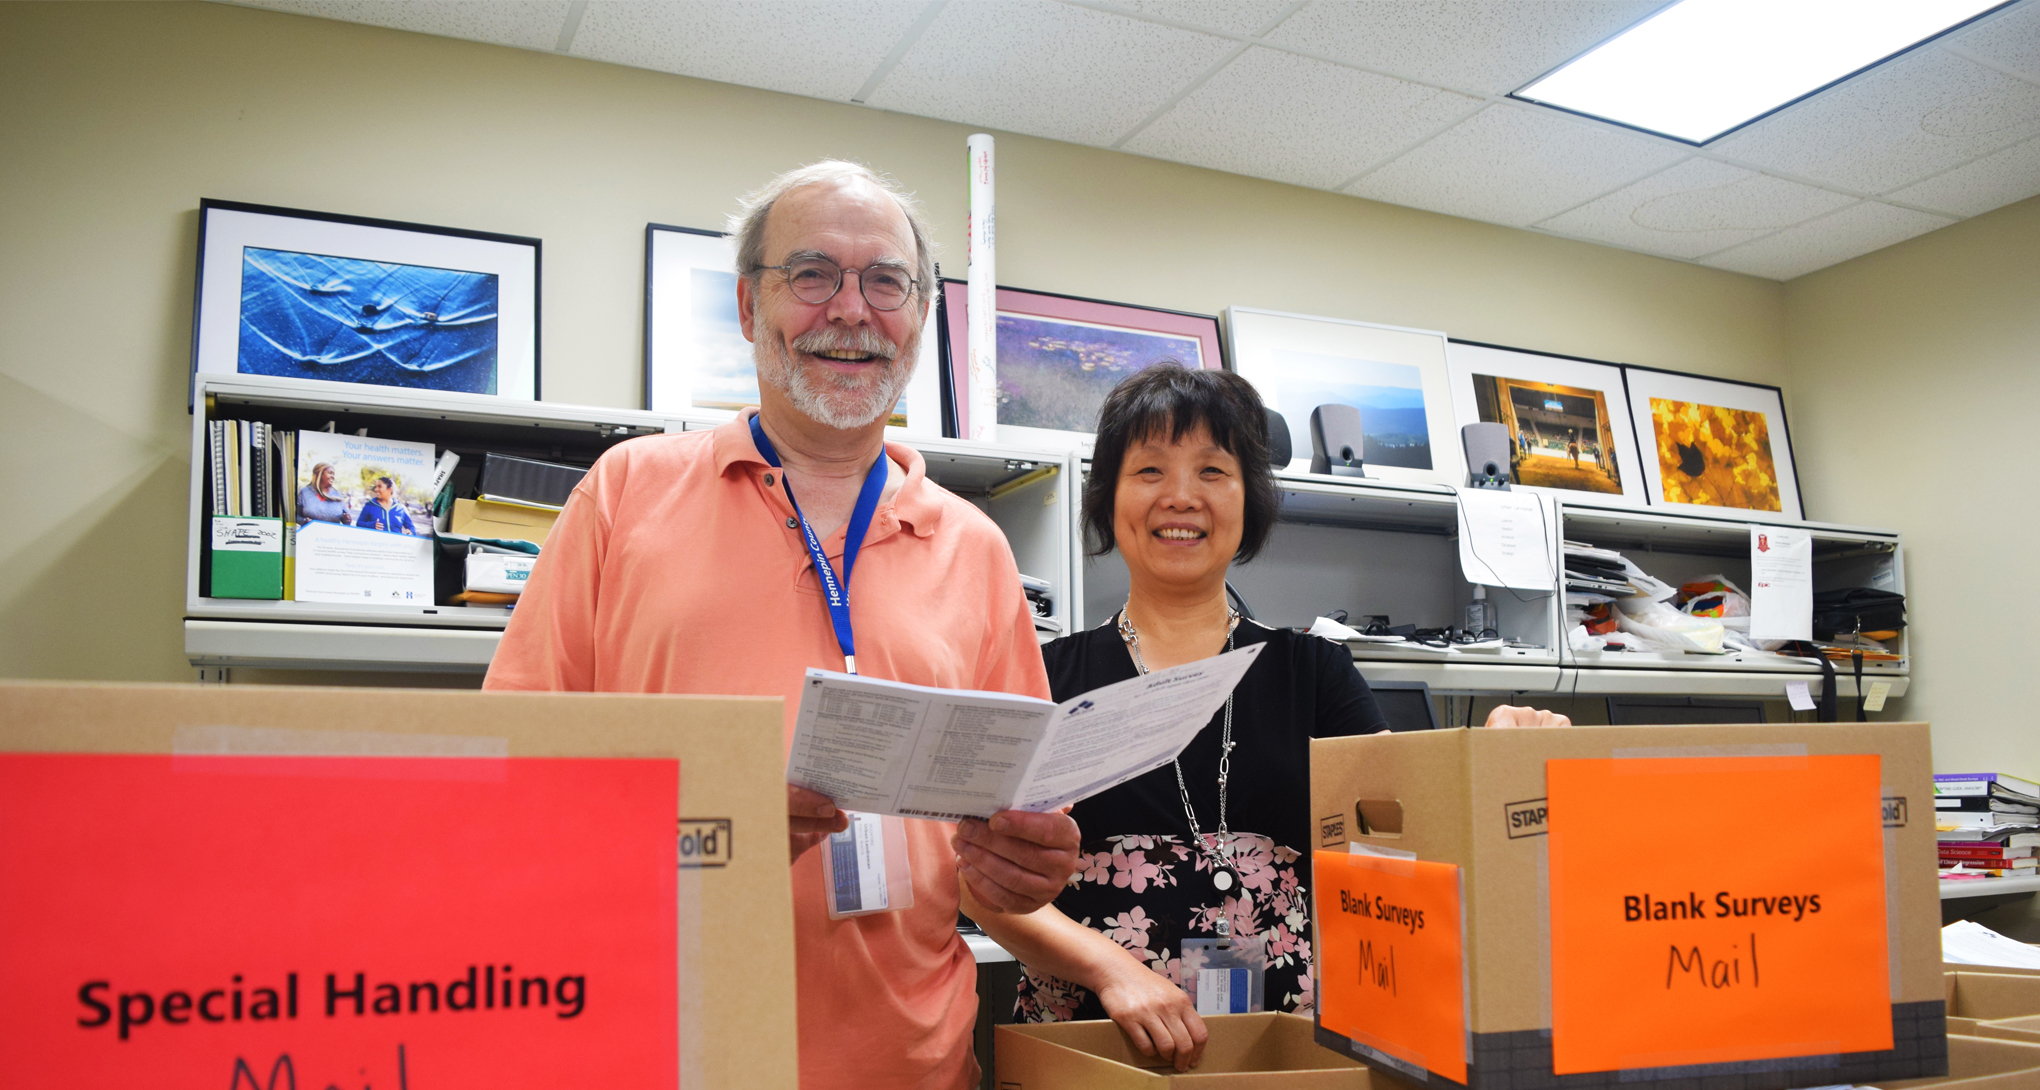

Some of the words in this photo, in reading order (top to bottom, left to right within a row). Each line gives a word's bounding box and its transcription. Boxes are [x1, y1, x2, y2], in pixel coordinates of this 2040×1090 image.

[342, 450, 361, 460] Your
[362, 453, 395, 464] answers
[396, 455, 425, 466] matter.
[343, 440, 363, 451] Your
[364, 442, 390, 454] health
[391, 445, 424, 457] matters.
[816, 553, 842, 607] Hennepin
[1322, 820, 1344, 840] STAPLES
[1340, 889, 1372, 919] Blank
[1375, 896, 1424, 935] Surveys
[1624, 892, 1705, 922] Blank
[1714, 891, 1821, 922] Surveys
[1358, 939, 1396, 998] Mail
[1667, 933, 1758, 990] Mail
[77, 972, 299, 1041] Special
[324, 964, 586, 1019] Handling
